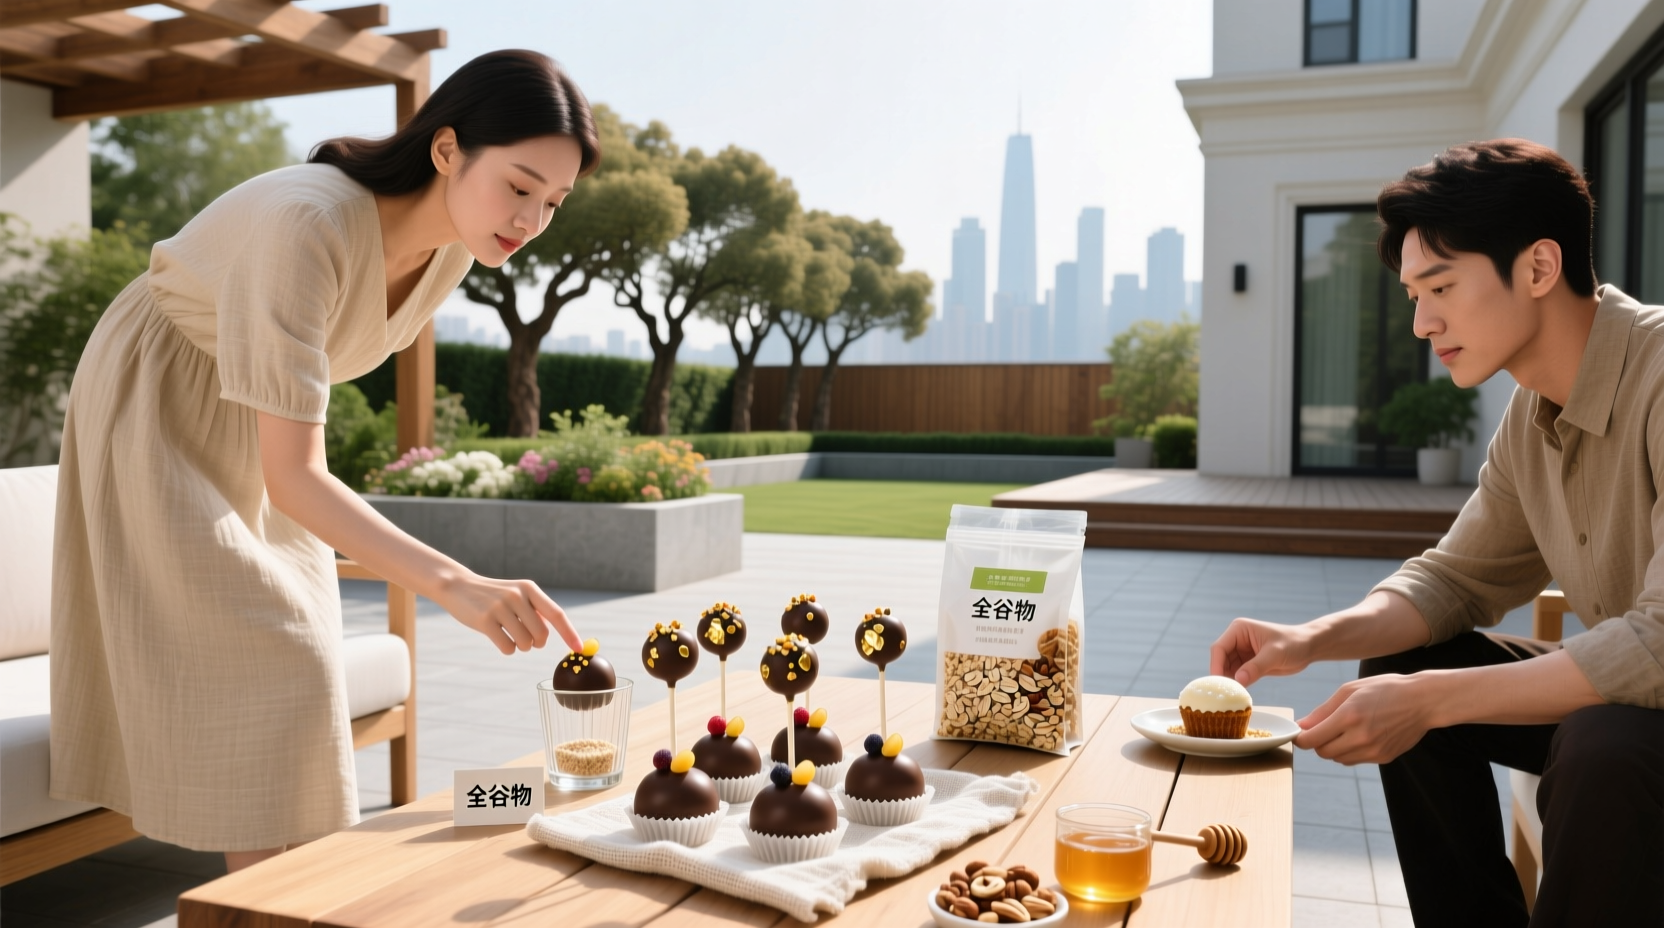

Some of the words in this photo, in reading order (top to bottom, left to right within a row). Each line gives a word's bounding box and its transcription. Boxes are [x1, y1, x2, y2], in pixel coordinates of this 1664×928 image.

[971, 596, 1036, 622] 全谷物
[466, 783, 532, 808] 全谷物
